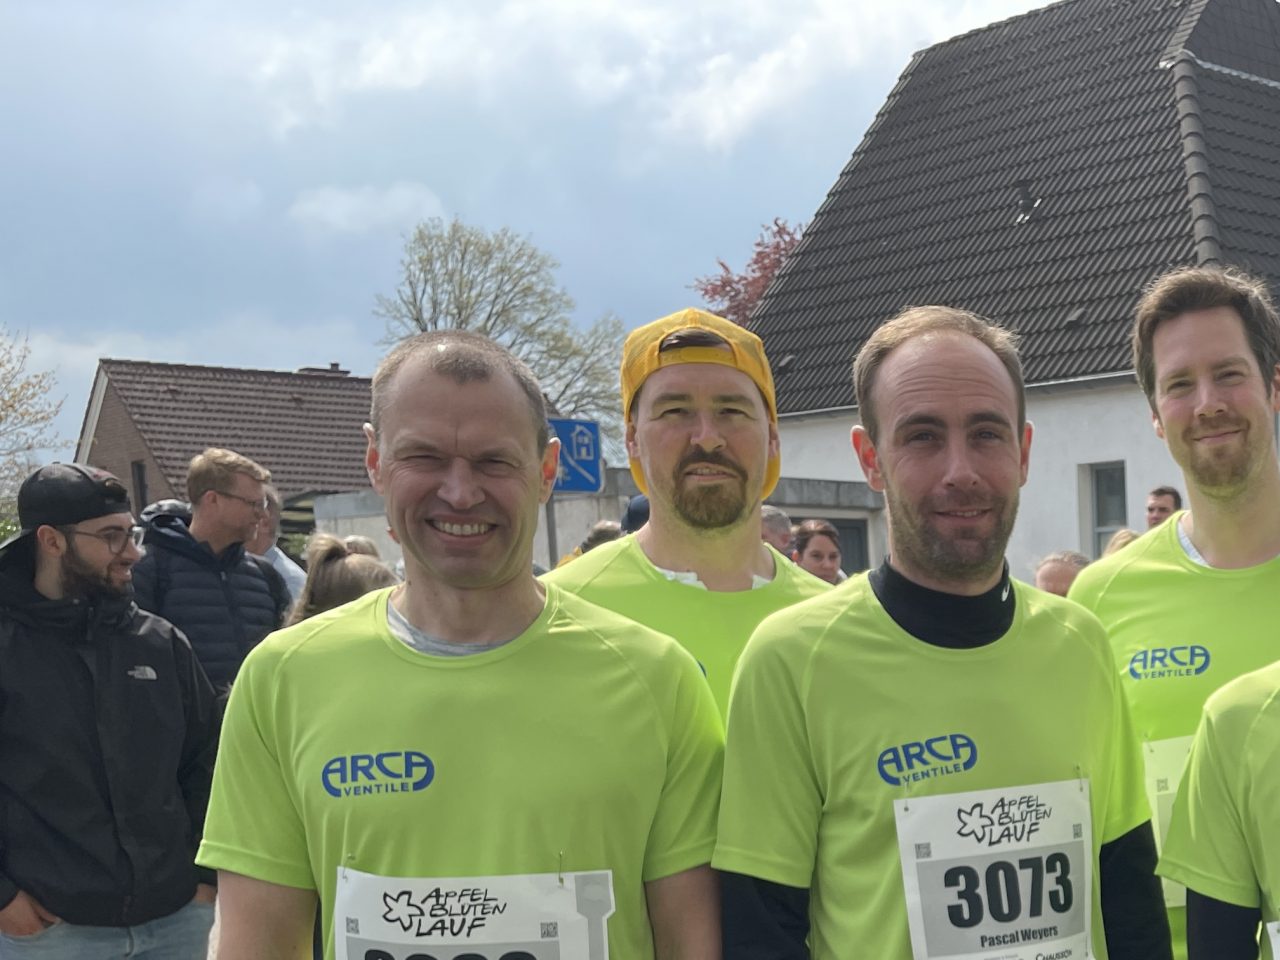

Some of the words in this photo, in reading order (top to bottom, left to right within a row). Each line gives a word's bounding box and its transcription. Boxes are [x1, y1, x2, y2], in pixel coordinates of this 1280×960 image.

[1129, 645, 1210, 680] ARCA
[1143, 669, 1192, 679] VENTILE
[878, 734, 977, 786] ARCA
[322, 751, 435, 798] ARCA
[902, 764, 963, 784] VENTILE
[344, 782, 409, 797] VENTILE
[991, 796, 1046, 814] APFEL
[989, 822, 1040, 846] LAUF
[421, 887, 498, 905] APFEL
[944, 852, 1073, 929] 3073
[416, 918, 486, 938] LAUF
[980, 931, 1019, 948] Pascal
[1021, 926, 1058, 941] Weyers
